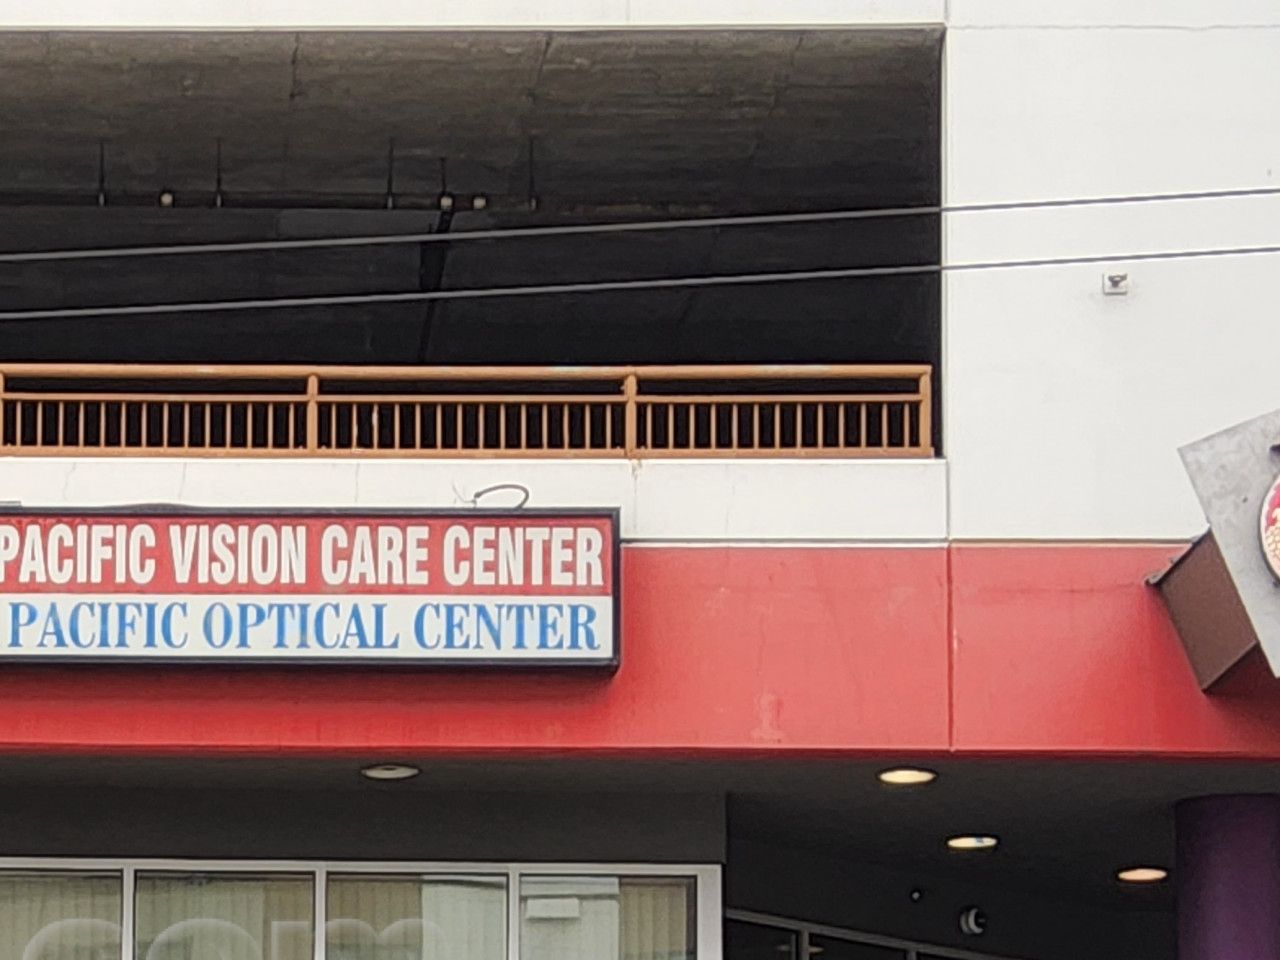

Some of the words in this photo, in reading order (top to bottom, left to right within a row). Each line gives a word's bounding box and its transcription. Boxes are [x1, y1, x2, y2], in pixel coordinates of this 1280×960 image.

[169, 524, 307, 586] VISION
[321, 524, 430, 586] CARE
[443, 524, 604, 587] CENTER
[7, 601, 189, 649] PACIFIC
[202, 601, 400, 650] OPTICAL
[413, 602, 601, 651] CENTER
